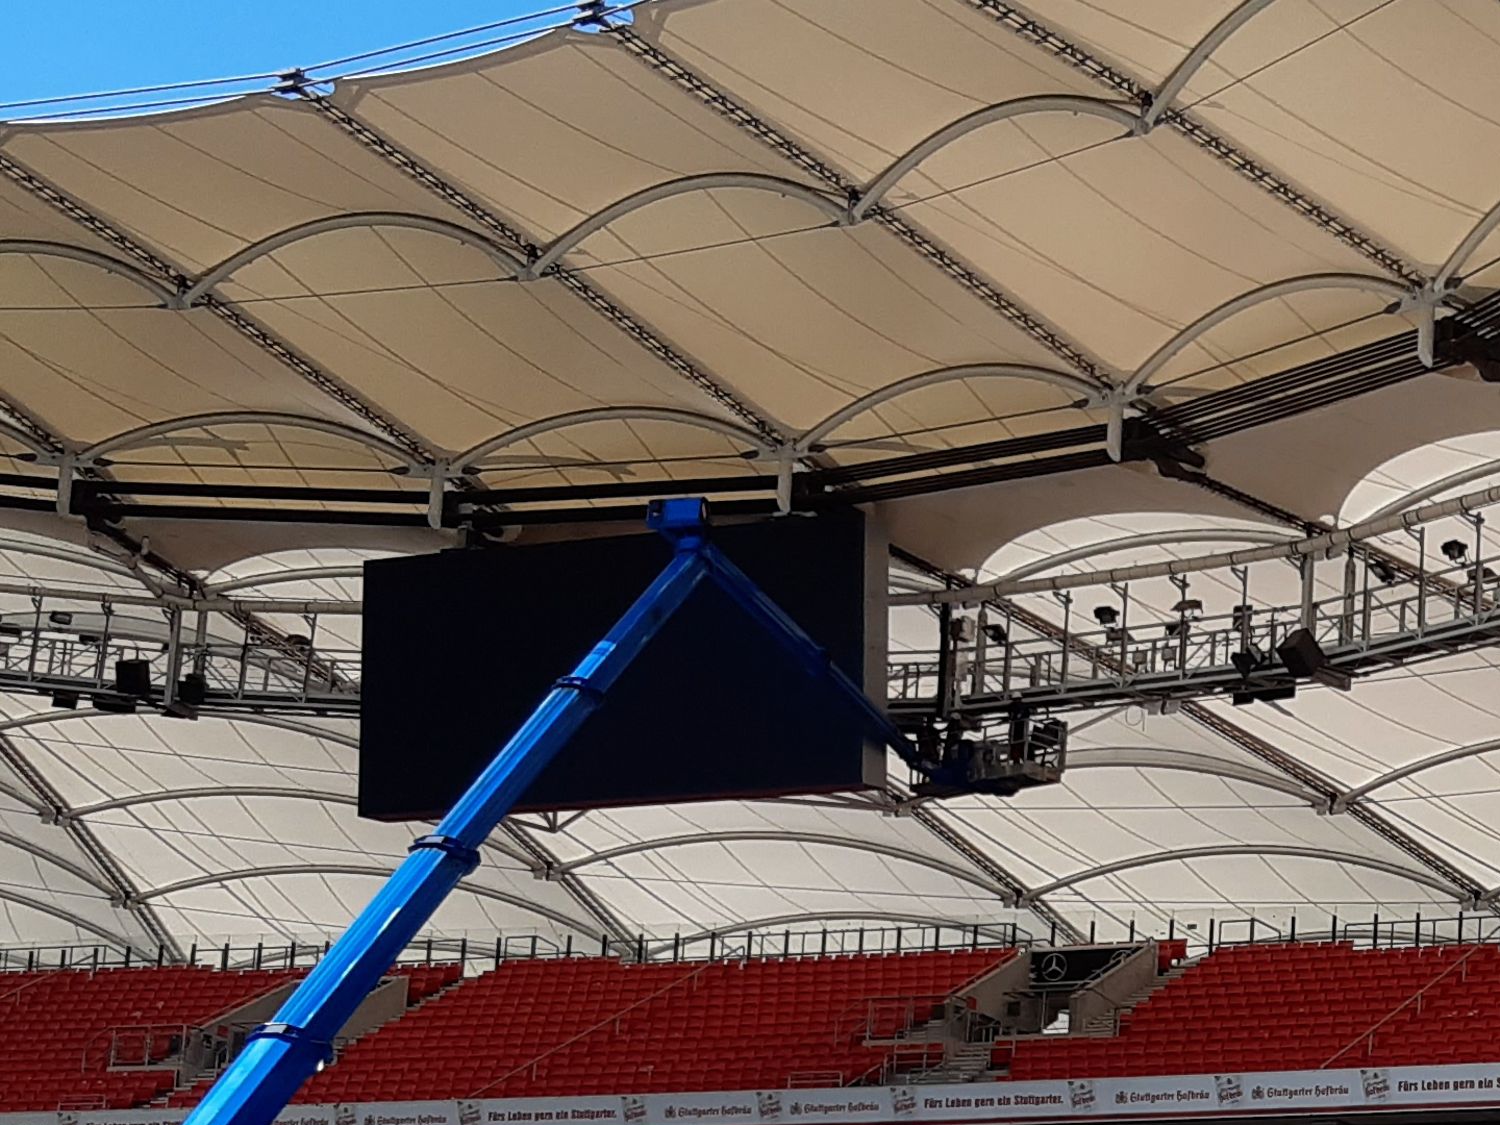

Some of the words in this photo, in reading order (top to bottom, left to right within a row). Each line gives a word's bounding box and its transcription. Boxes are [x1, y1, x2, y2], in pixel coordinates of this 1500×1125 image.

[1398, 1080, 1418, 1092] Fürs
[1421, 1079, 1450, 1091] Leben
[1453, 1081, 1474, 1092] gern
[1477, 1079, 1493, 1089] ein
